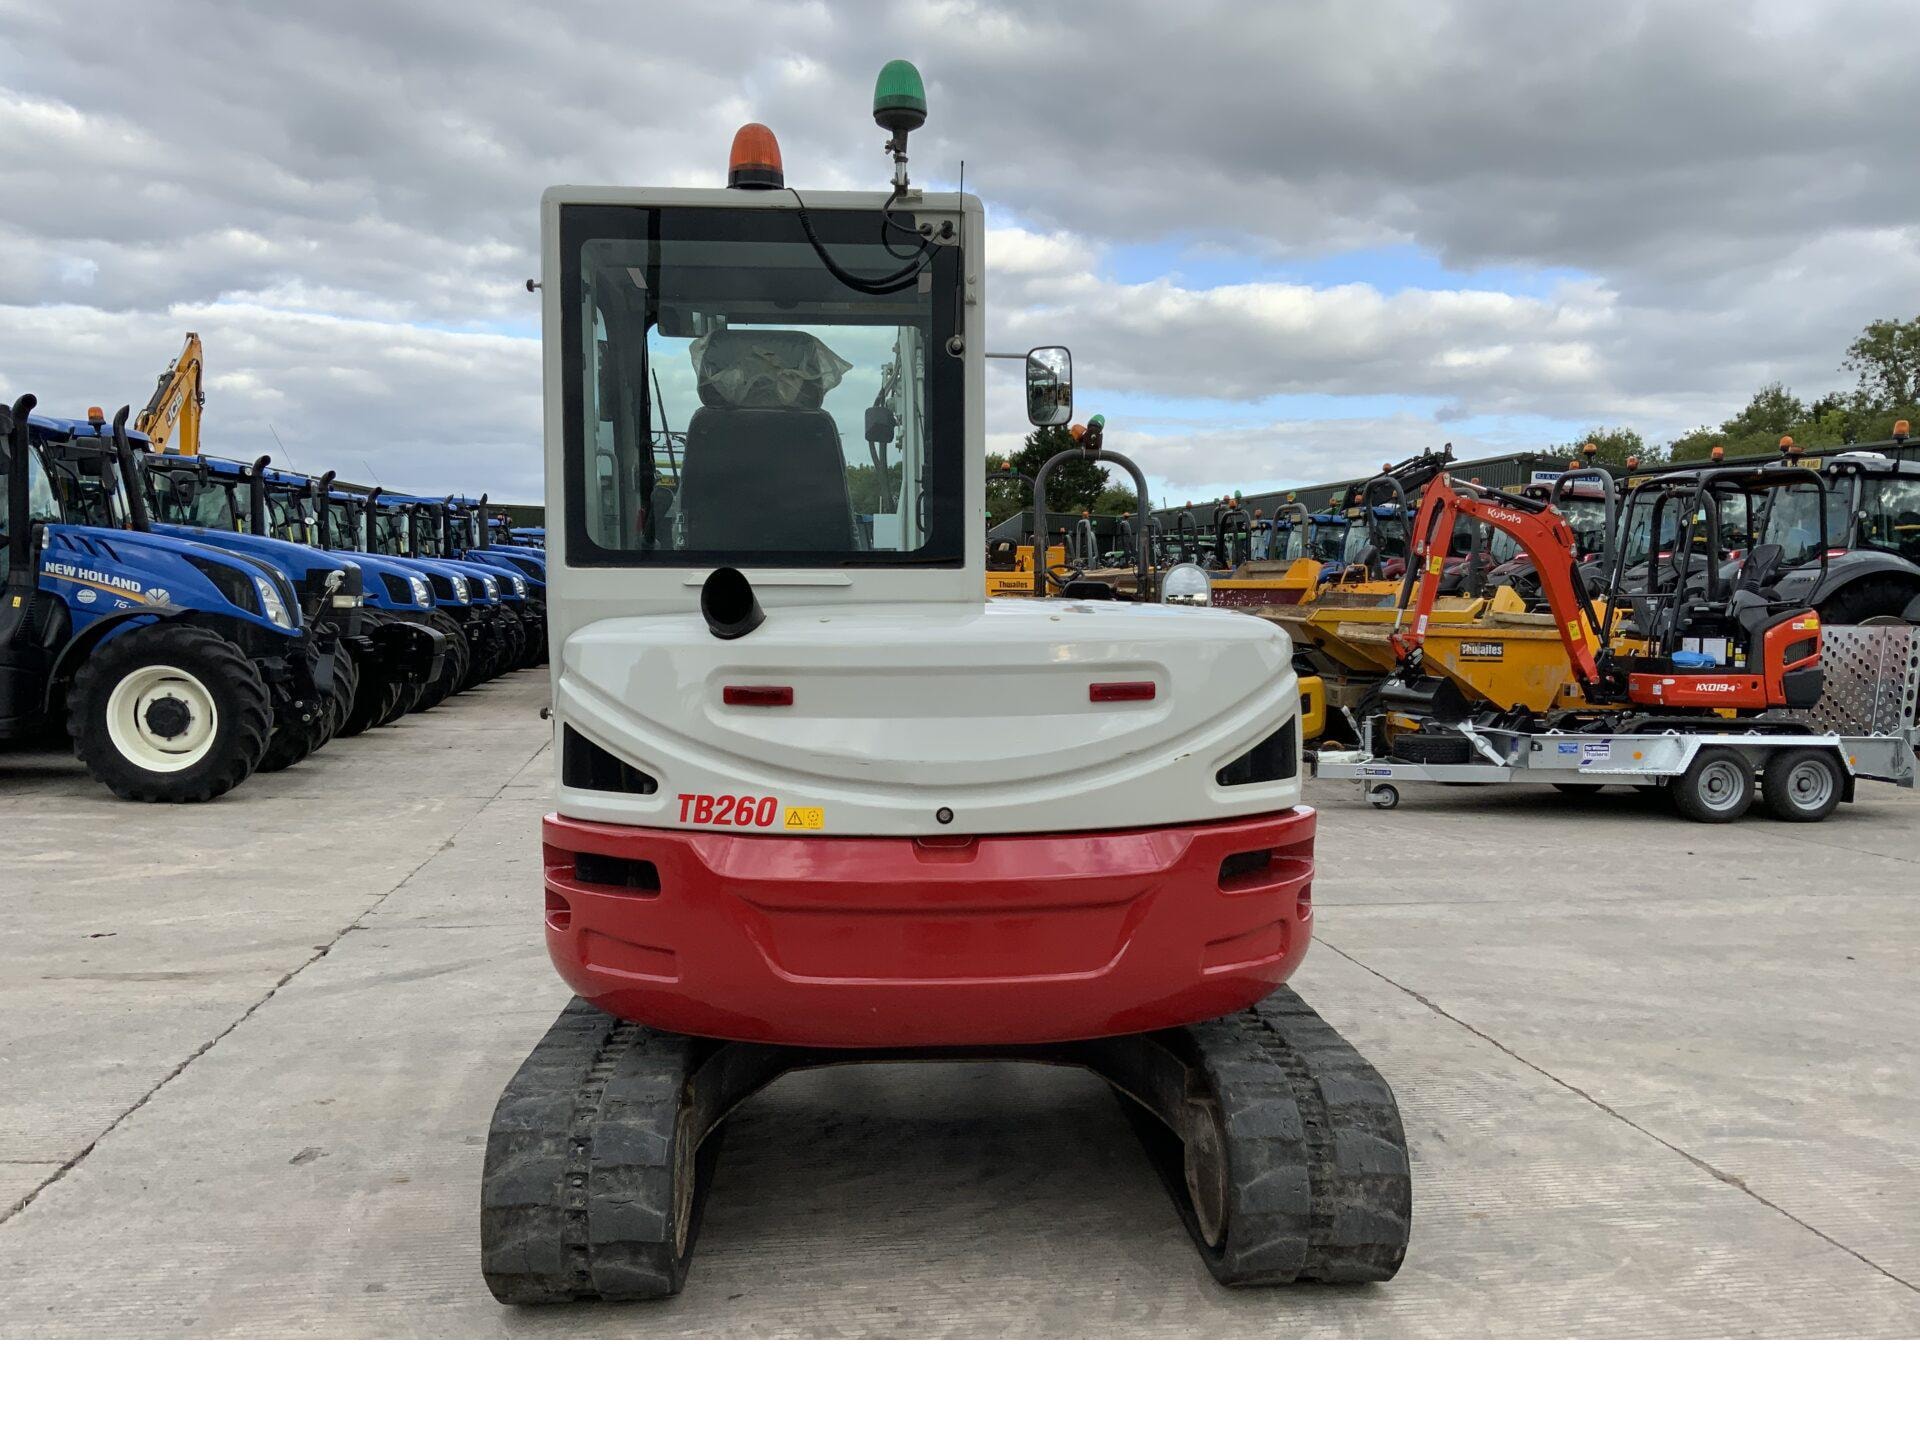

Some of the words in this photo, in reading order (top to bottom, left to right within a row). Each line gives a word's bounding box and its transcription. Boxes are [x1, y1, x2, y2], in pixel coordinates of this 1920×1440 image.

[167, 391, 183, 427] JCB
[1487, 508, 1522, 524] Kubota
[45, 561, 76, 577] NEW
[78, 567, 142, 593] HOLLAND
[1695, 683, 1736, 692] KX019-4
[678, 794, 778, 827] TB260
